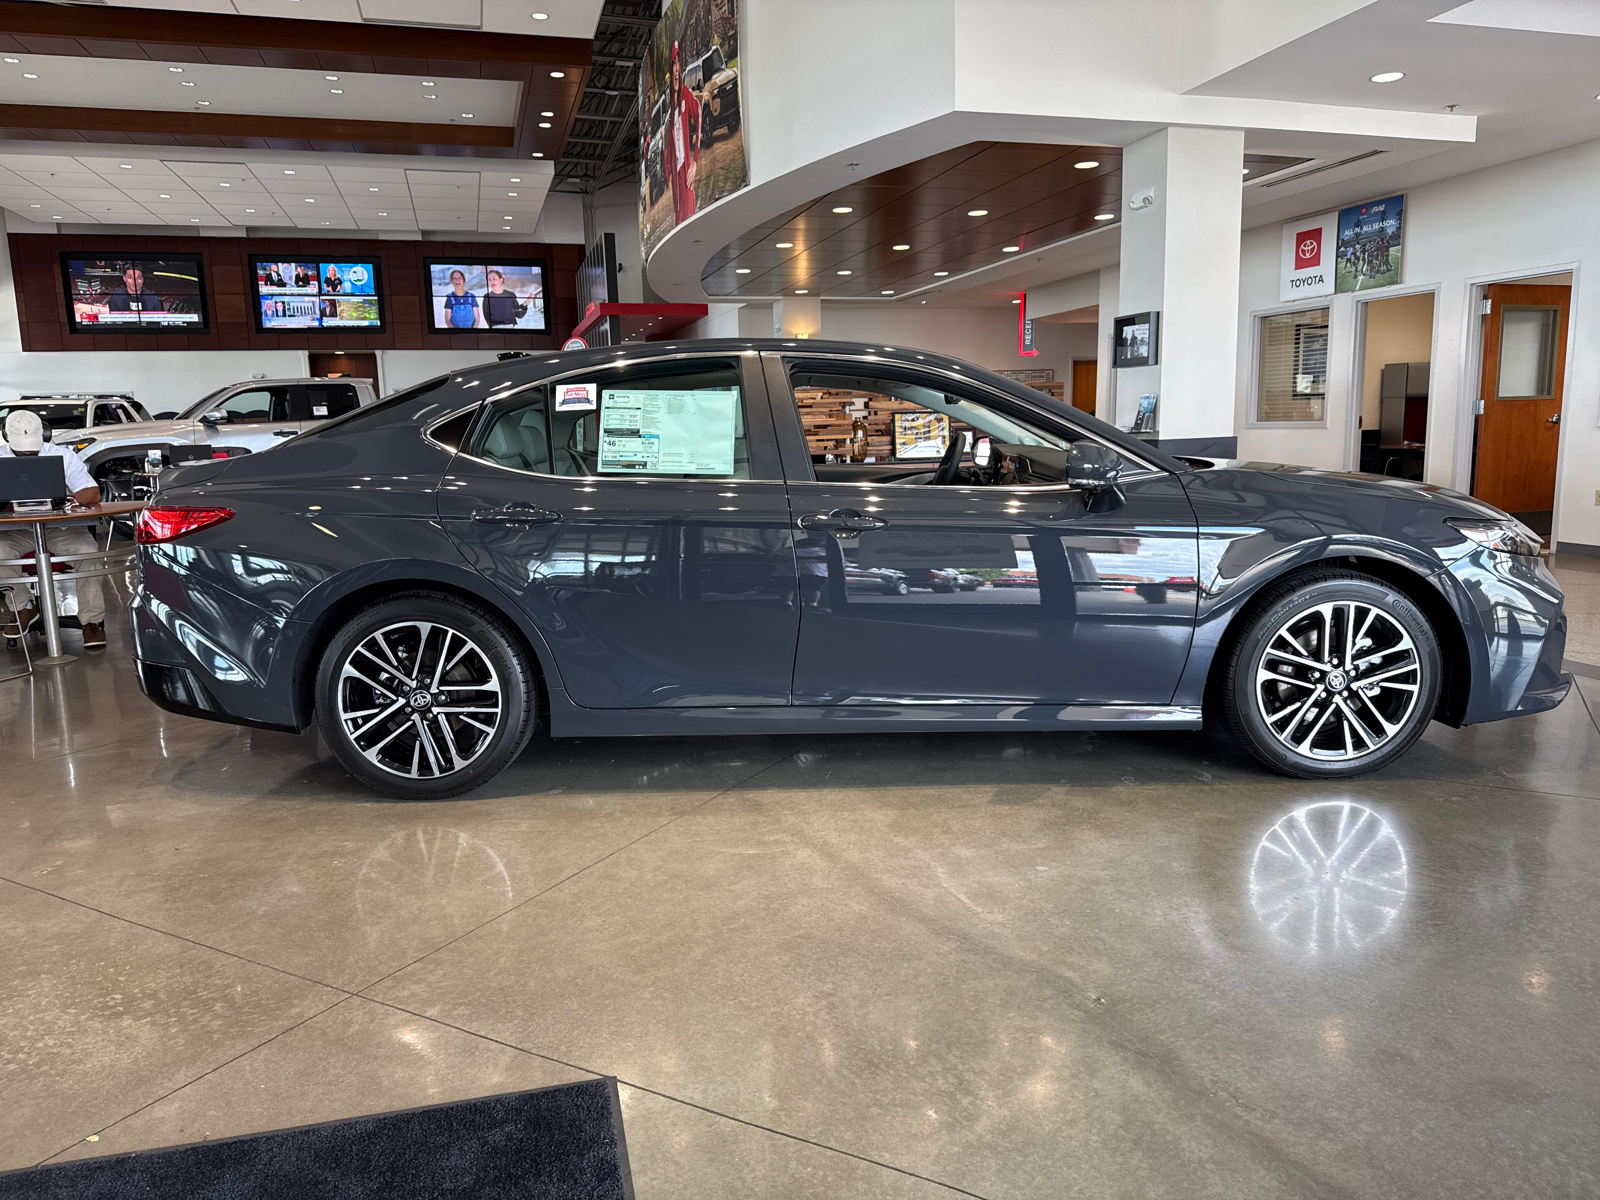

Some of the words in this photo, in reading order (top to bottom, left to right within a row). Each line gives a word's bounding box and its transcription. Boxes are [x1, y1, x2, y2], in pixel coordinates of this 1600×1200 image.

[1344, 227, 1354, 236] ALL
[1362, 224, 1372, 232] ALL
[1372, 218, 1397, 230] SEASON.
[1290, 275, 1325, 289] TOYOTA
[1391, 599, 1428, 637] Continental
